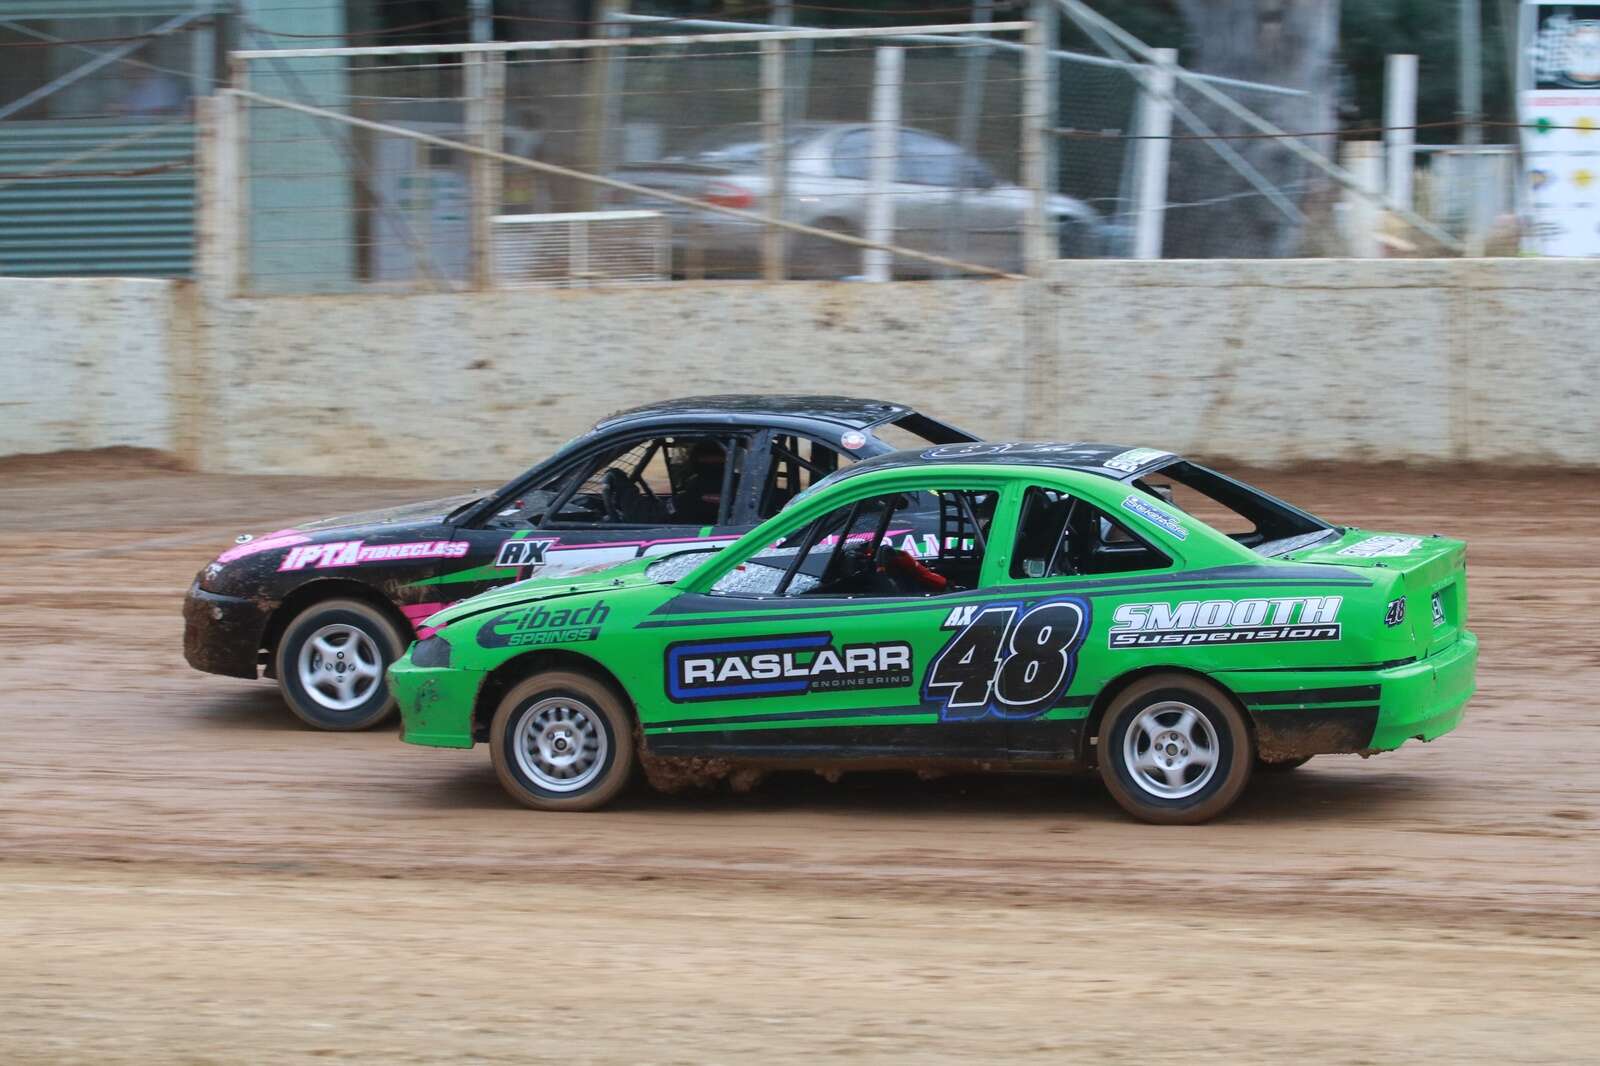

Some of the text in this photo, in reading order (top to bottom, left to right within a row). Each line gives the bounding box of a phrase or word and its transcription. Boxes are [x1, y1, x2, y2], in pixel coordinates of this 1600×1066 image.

[283, 542, 468, 570] IPTA FIBREGLASS
[498, 541, 549, 566] AX
[480, 600, 609, 642] Eibach
[946, 606, 976, 627] AX
[1113, 597, 1342, 629] SMOOTH
[1384, 597, 1405, 627] 48
[509, 629, 591, 645] SPRINGS
[1113, 627, 1337, 645] Suspension
[684, 645, 910, 683] RASLARR
[928, 600, 1083, 708] 48
[812, 675, 910, 687] ENGINEERING
